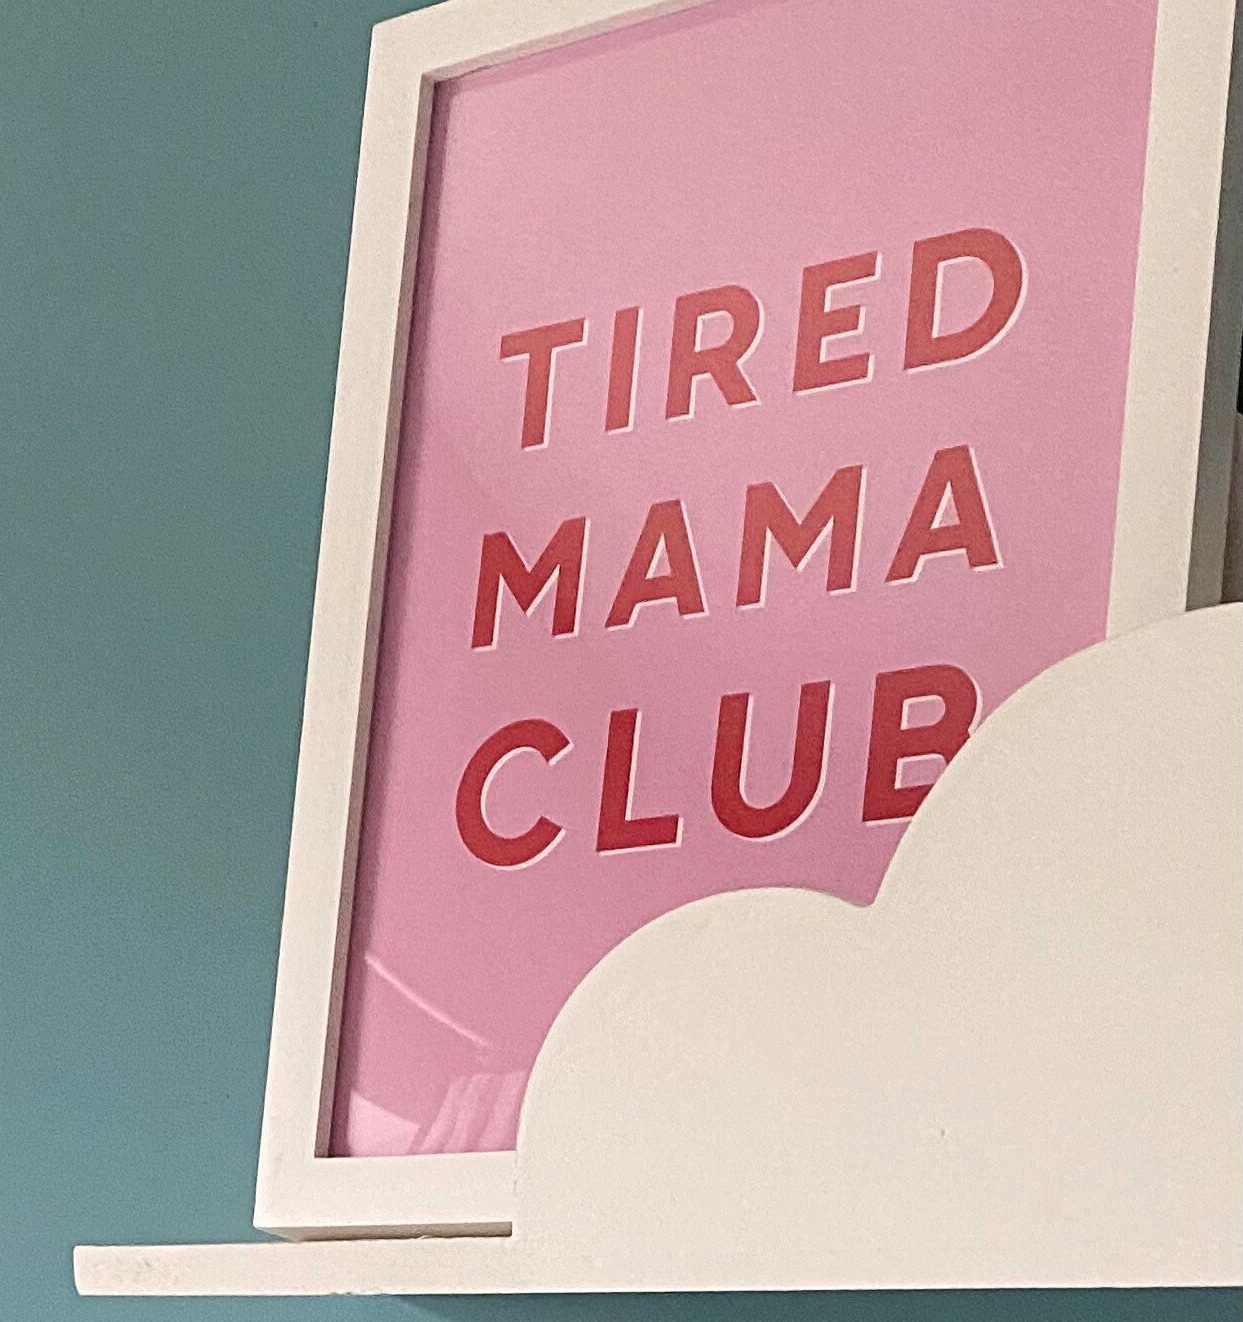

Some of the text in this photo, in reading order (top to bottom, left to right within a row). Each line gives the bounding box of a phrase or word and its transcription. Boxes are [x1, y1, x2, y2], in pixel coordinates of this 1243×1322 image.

[499, 227, 1029, 451] TIRED
[471, 444, 1003, 651] MAMA
[454, 663, 982, 870] CLUB
